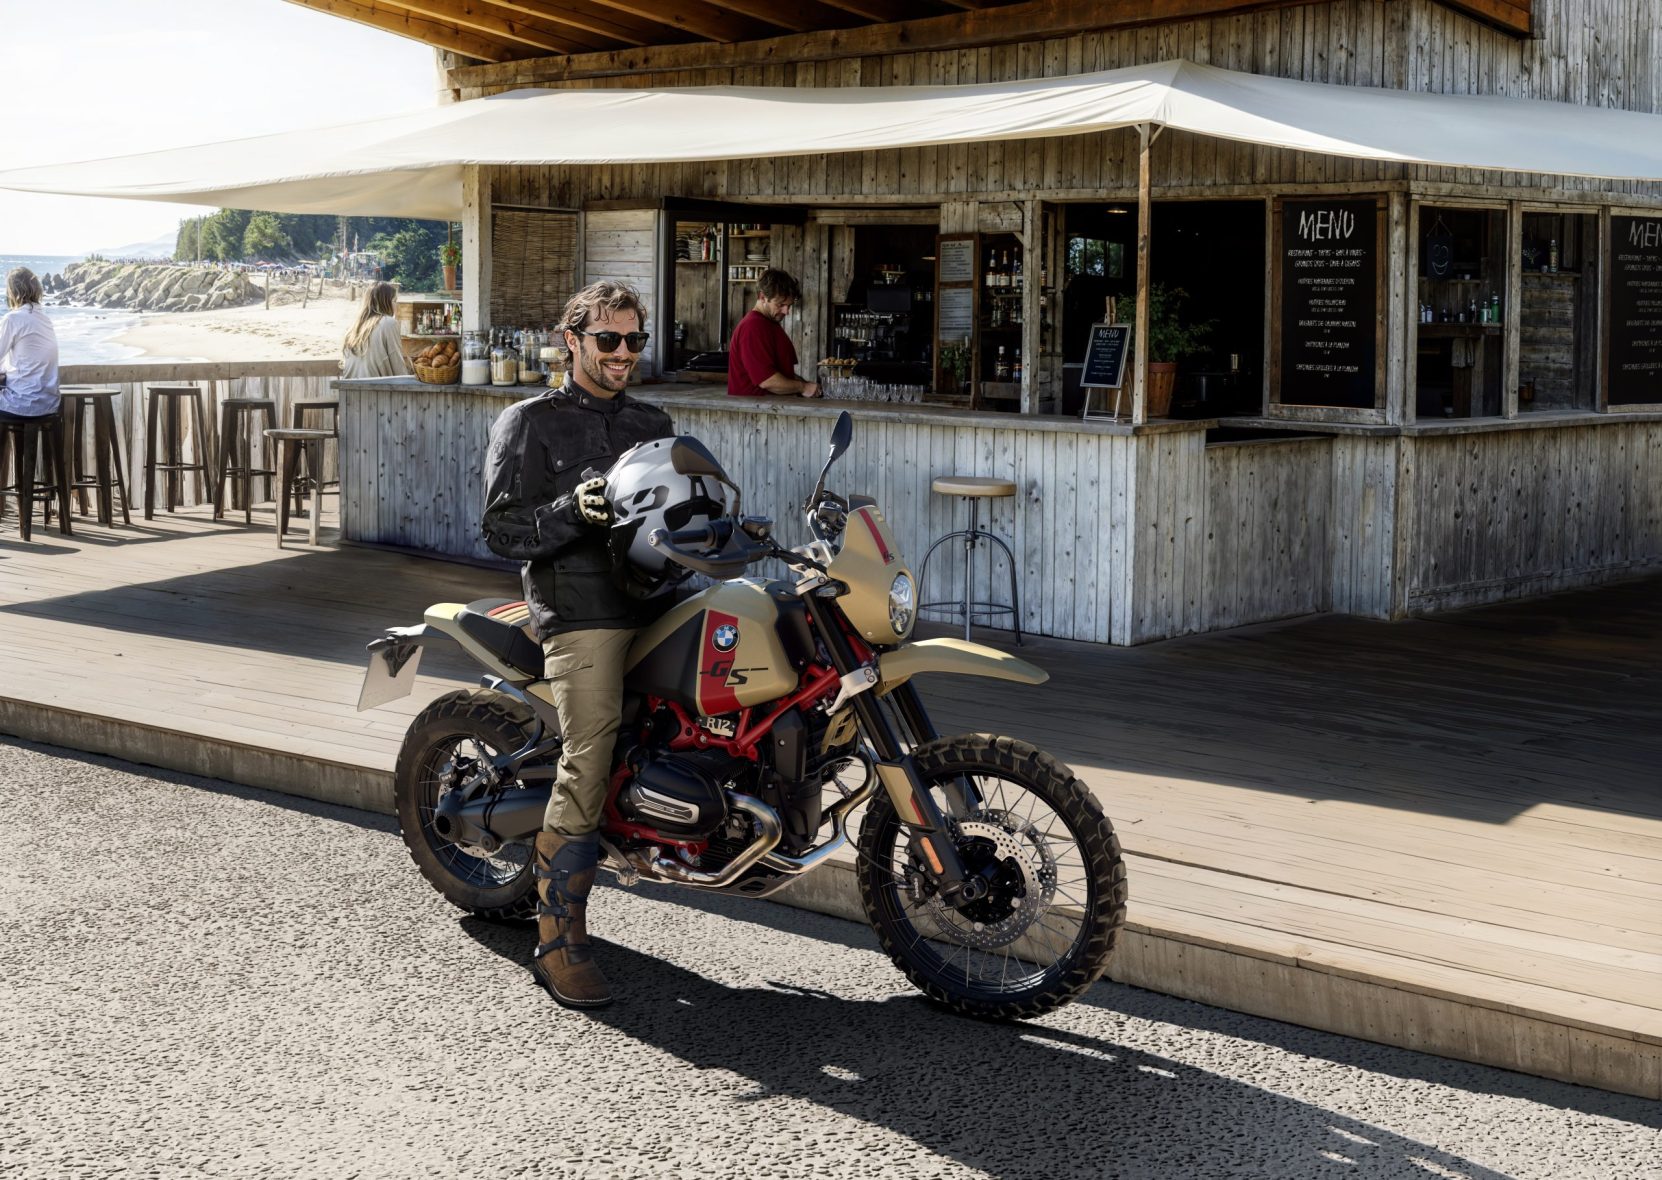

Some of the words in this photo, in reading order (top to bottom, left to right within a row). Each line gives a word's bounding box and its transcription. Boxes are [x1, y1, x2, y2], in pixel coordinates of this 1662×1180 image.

[1299, 209, 1354, 242] MENU
[707, 660, 752, 686] GS
[706, 717, 731, 730] R12
